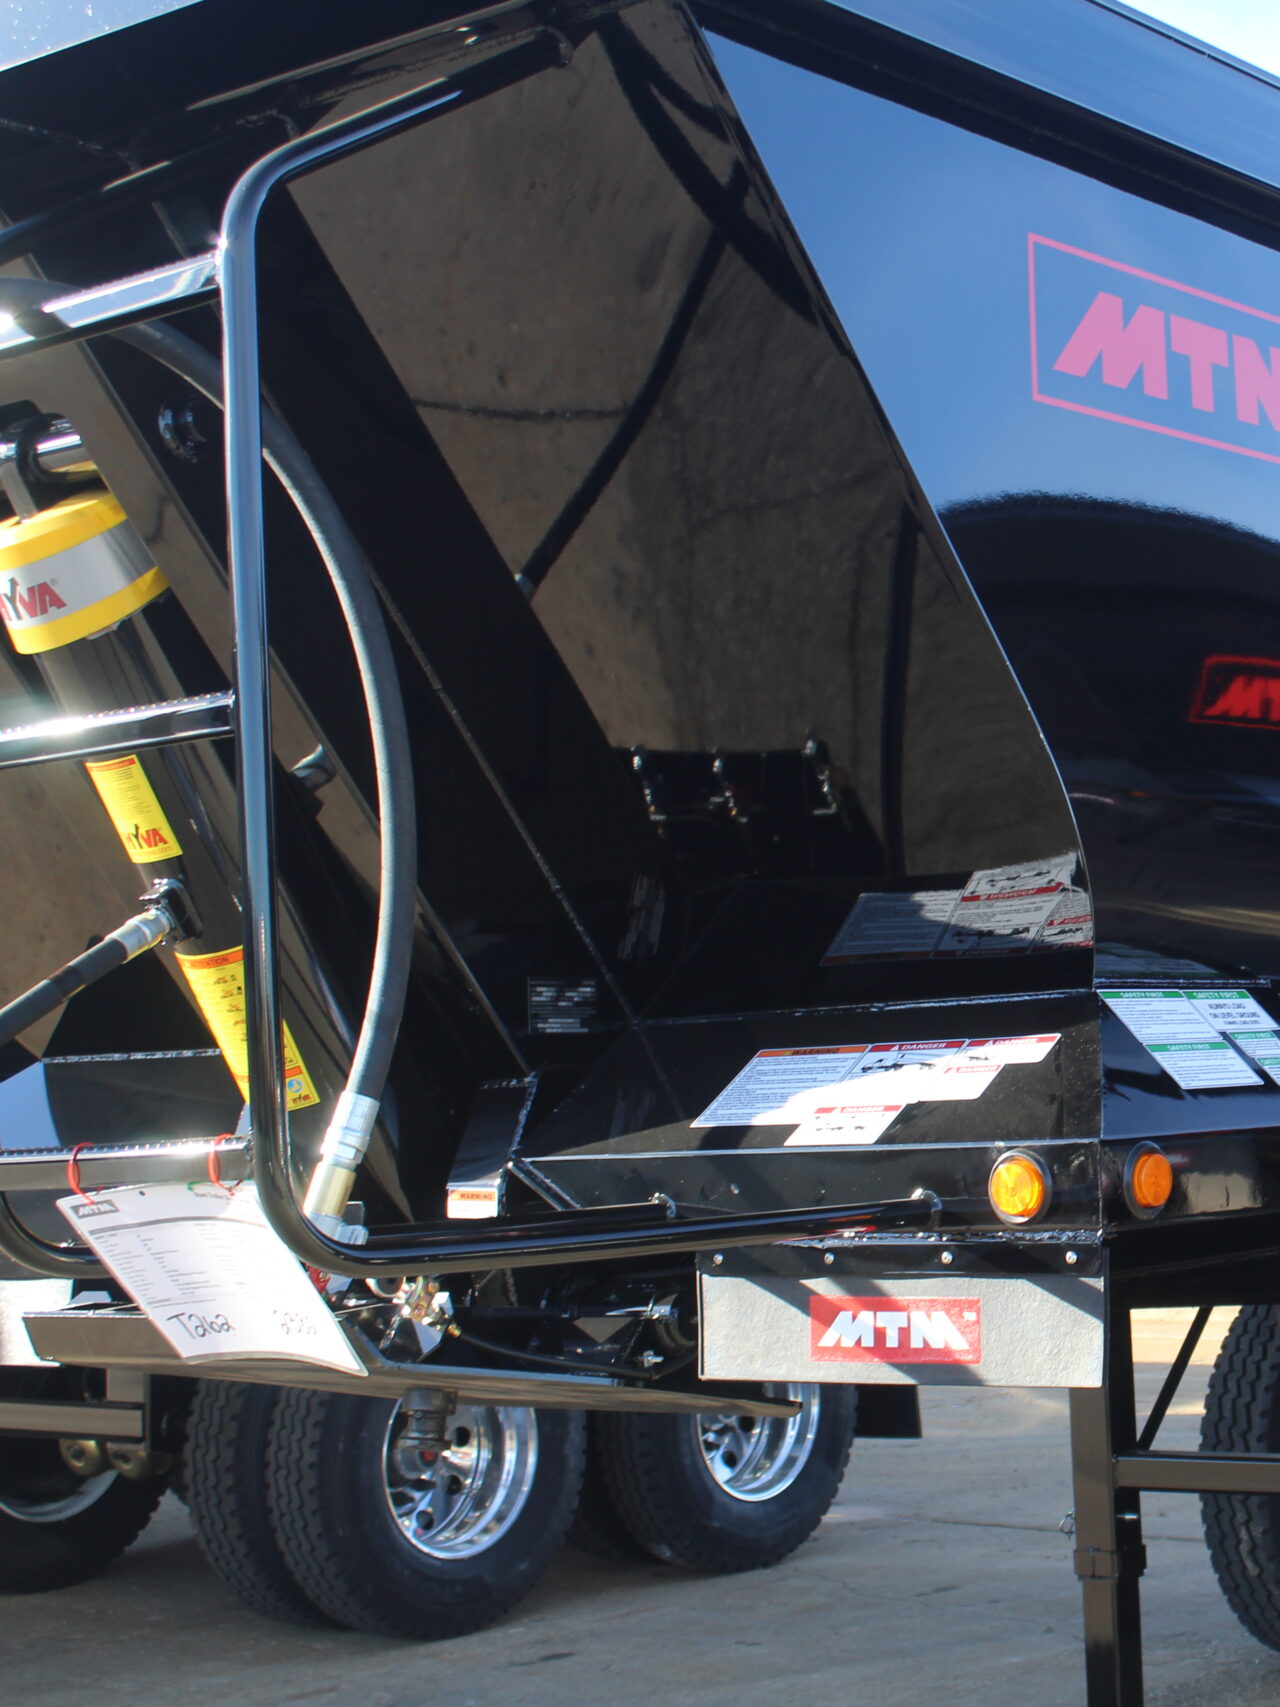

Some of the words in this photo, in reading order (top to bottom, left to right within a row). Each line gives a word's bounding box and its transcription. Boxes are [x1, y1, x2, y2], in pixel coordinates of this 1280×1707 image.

[1193, 991, 1218, 999] SAFETY
[1219, 991, 1240, 999] FIRST
[817, 1311, 970, 1350] MTM
